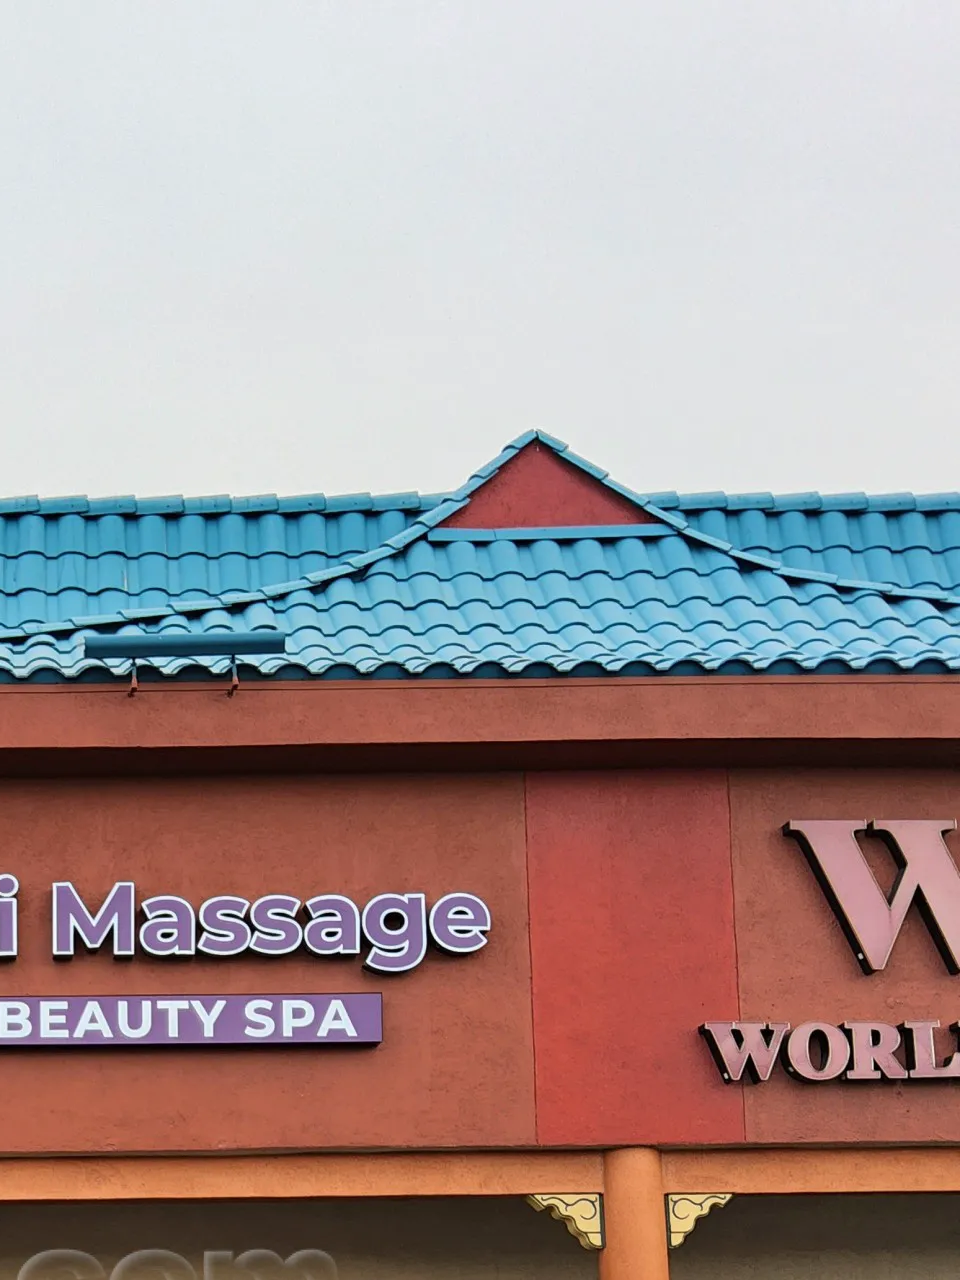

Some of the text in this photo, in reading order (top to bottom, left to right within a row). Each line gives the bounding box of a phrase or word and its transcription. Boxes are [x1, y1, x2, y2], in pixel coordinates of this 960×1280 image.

[52, 881, 491, 972] Massage
[244, 999, 357, 1037] SPA
[702, 1021, 960, 1081] WORL
